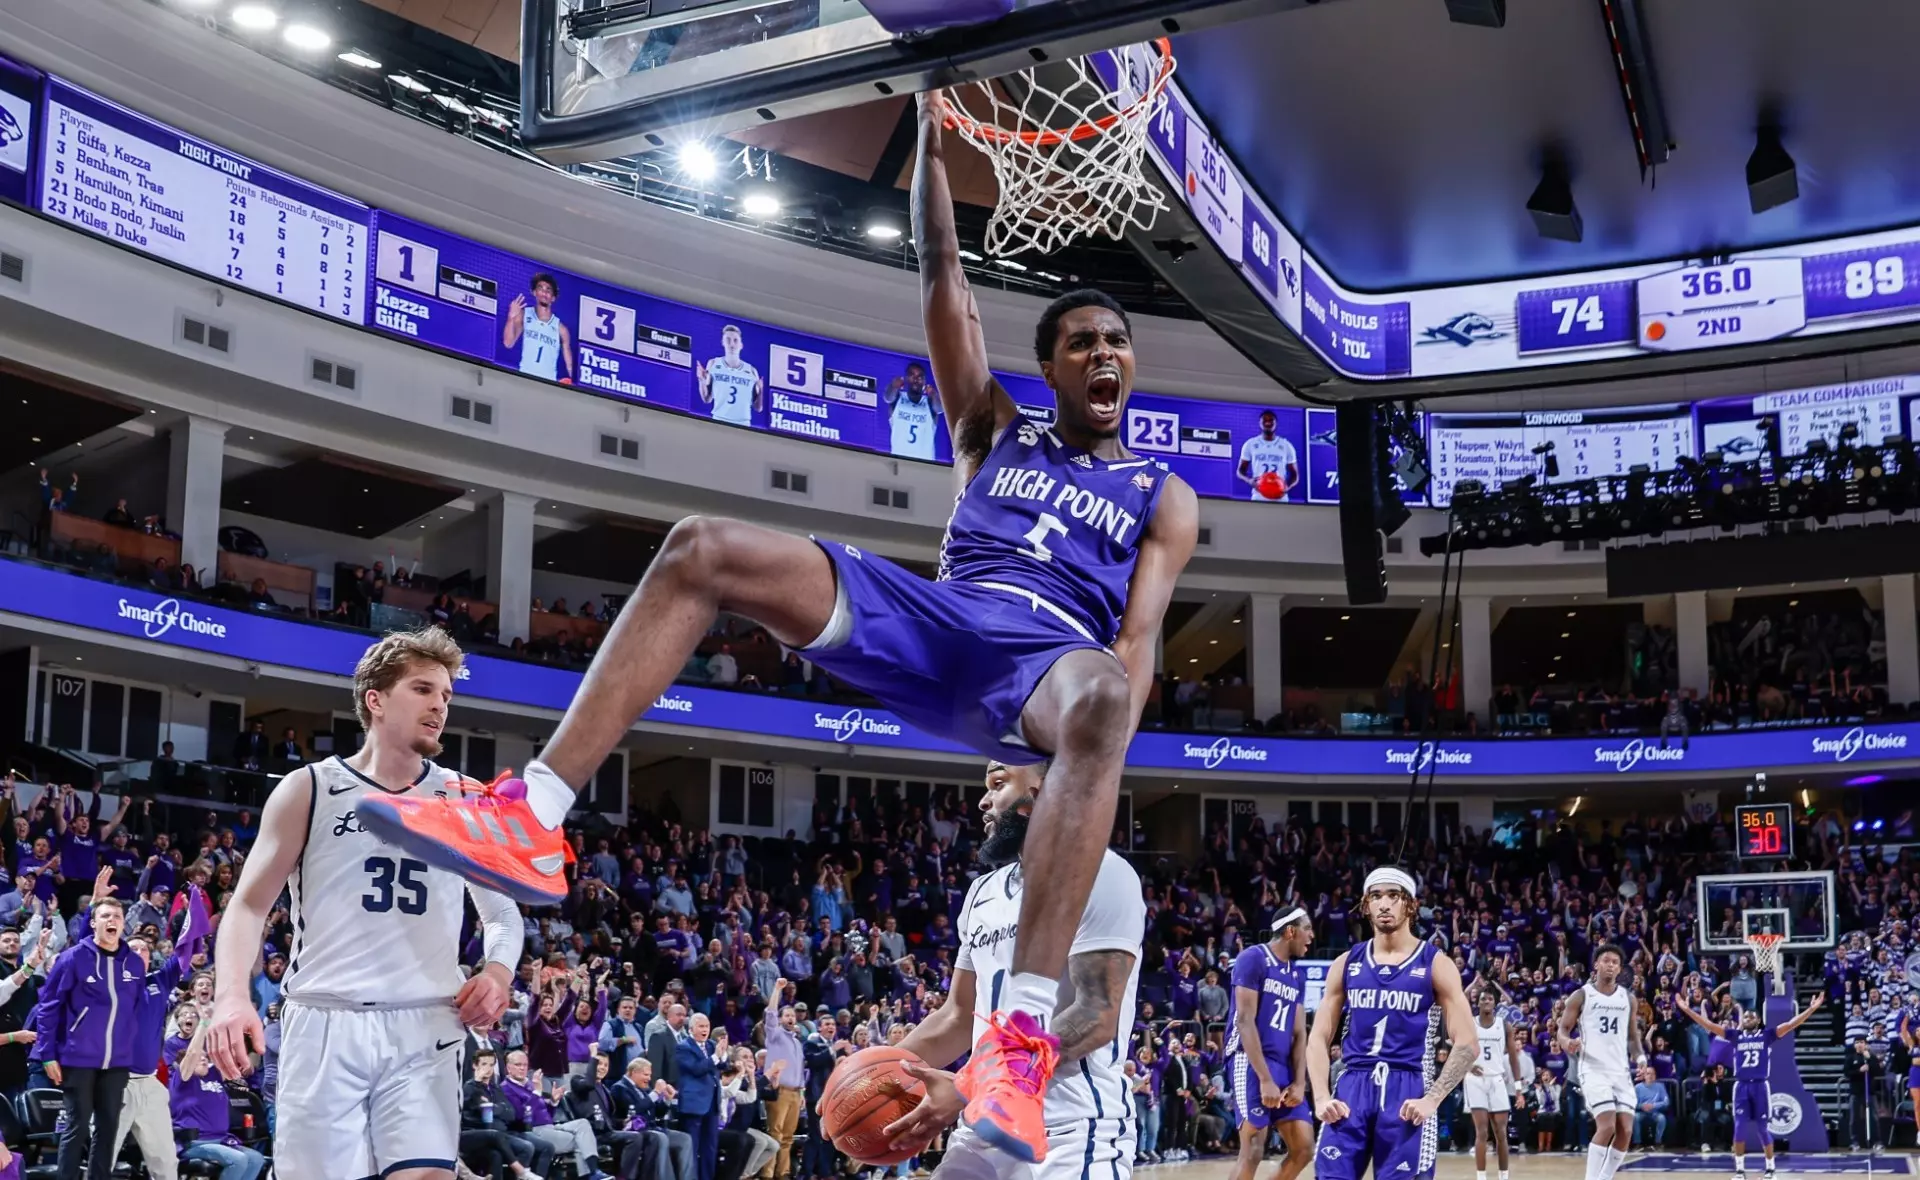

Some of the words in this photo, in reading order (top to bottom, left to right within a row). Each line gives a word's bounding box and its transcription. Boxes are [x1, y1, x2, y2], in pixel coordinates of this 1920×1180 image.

[60, 108, 94, 132] Player
[226, 178, 256, 198] Points
[261, 191, 308, 217] Rebounds
[311, 210, 344, 231] Assists
[348, 224, 354, 234] F
[179, 140, 210, 165] HIGH
[213, 155, 251, 180] POINT
[1202, 140, 1226, 196] 36.0
[60, 122, 66, 136] 1
[78, 130, 109, 157] Giffa,
[114, 144, 151, 172] Kezza
[230, 192, 247, 209] 24
[279, 211, 286, 223] 2
[322, 226, 329, 238] 7
[346, 236, 354, 248] 2
[57, 140, 66, 155] 3
[137, 172, 164, 194] Trae
[230, 210, 245, 225] 18
[278, 228, 286, 240] 5
[321, 244, 328, 256] 0
[347, 252, 353, 264] 1
[56, 160, 64, 175] 5
[75, 168, 135, 206] Hamilton,
[140, 194, 184, 222] Kimani
[229, 229, 245, 244] 14
[277, 247, 285, 259] 4
[320, 261, 328, 274] 8
[344, 270, 352, 282] 2
[1208, 206, 1221, 235] 2ND
[50, 178, 68, 196] 21
[74, 187, 106, 211] Bodo
[111, 202, 145, 230] Bodo,
[231, 247, 239, 260] 7
[276, 264, 284, 276] 6
[321, 279, 326, 291] 1
[344, 286, 352, 299] 3
[1252, 221, 1269, 266] 89
[48, 197, 67, 215] 23
[73, 206, 110, 235] Miles,
[116, 222, 147, 246] Duke
[226, 265, 243, 280] 12
[277, 282, 283, 294] 1
[320, 296, 325, 308] 1
[342, 304, 350, 316] 3
[398, 246, 414, 282] 1
[454, 274, 482, 291] Guard
[1682, 268, 1751, 298] 36.0
[1845, 257, 1904, 299] 89
[376, 286, 430, 320] Kezza
[462, 294, 475, 306] JR
[376, 306, 418, 336] Giffa
[595, 307, 616, 341] 3
[1340, 310, 1378, 330] FOULS
[1552, 295, 1604, 335] 74
[1698, 317, 1741, 337] 2ND
[651, 330, 678, 346] Guard
[1332, 331, 1337, 348] 2
[1343, 338, 1370, 359] TOL
[534, 346, 543, 363] 1
[580, 347, 620, 373] Trae
[658, 350, 671, 360] JR
[580, 366, 646, 398] Benham
[787, 354, 806, 387] 5
[833, 373, 869, 388] Forward
[727, 386, 737, 404] 3
[772, 393, 828, 419] Kimani
[1772, 392, 1809, 408] TEAM
[1814, 380, 1904, 402] COMPARISON
[771, 412, 840, 440] Hamilton
[1134, 416, 1173, 446] 23
[1526, 412, 1583, 425] LONGWOOD
[907, 425, 918, 444] 5
[1193, 429, 1217, 440] Guard
[1440, 441, 1445, 450] 1
[1574, 438, 1587, 448] 14
[1614, 437, 1620, 446] 2
[1652, 434, 1658, 443] 7
[1200, 445, 1211, 453] JR
[1440, 454, 1446, 462] 3
[1577, 452, 1584, 460] 4
[1326, 471, 1339, 489] 7
[1574, 466, 1588, 475] 12
[988, 467, 1056, 501] HIGH
[1053, 484, 1136, 544] POINT
[118, 598, 164, 625] Smart
[180, 612, 226, 638] Choice
[56, 678, 84, 697] 107
[815, 713, 850, 731] Smart
[862, 718, 901, 735] Choice
[1184, 743, 1219, 758] Smart
[1230, 745, 1267, 760] Choice
[1386, 749, 1416, 763] Smar
[1595, 747, 1632, 762] Smart
[1644, 745, 1684, 760] Choice
[1812, 737, 1851, 753] Smart
[1865, 733, 1907, 749] Choice
[751, 771, 774, 785] 106
[1743, 812, 1775, 827] 36.0
[1749, 827, 1781, 854] 30
[362, 856, 427, 916] 35
[969, 923, 1018, 956] Longwo
[1263, 978, 1281, 995] HIGH
[1281, 985, 1299, 1002] POINT
[1348, 989, 1377, 1008] HIGH
[1378, 990, 1423, 1012] POINT
[1270, 999, 1290, 1031] 21
[1600, 1016, 1618, 1034] 34
[1366, 1015, 1388, 1056] 1
[1749, 1042, 1764, 1050] POINT
[1484, 1047, 1491, 1061] 5
[1742, 1051, 1760, 1068] 23
